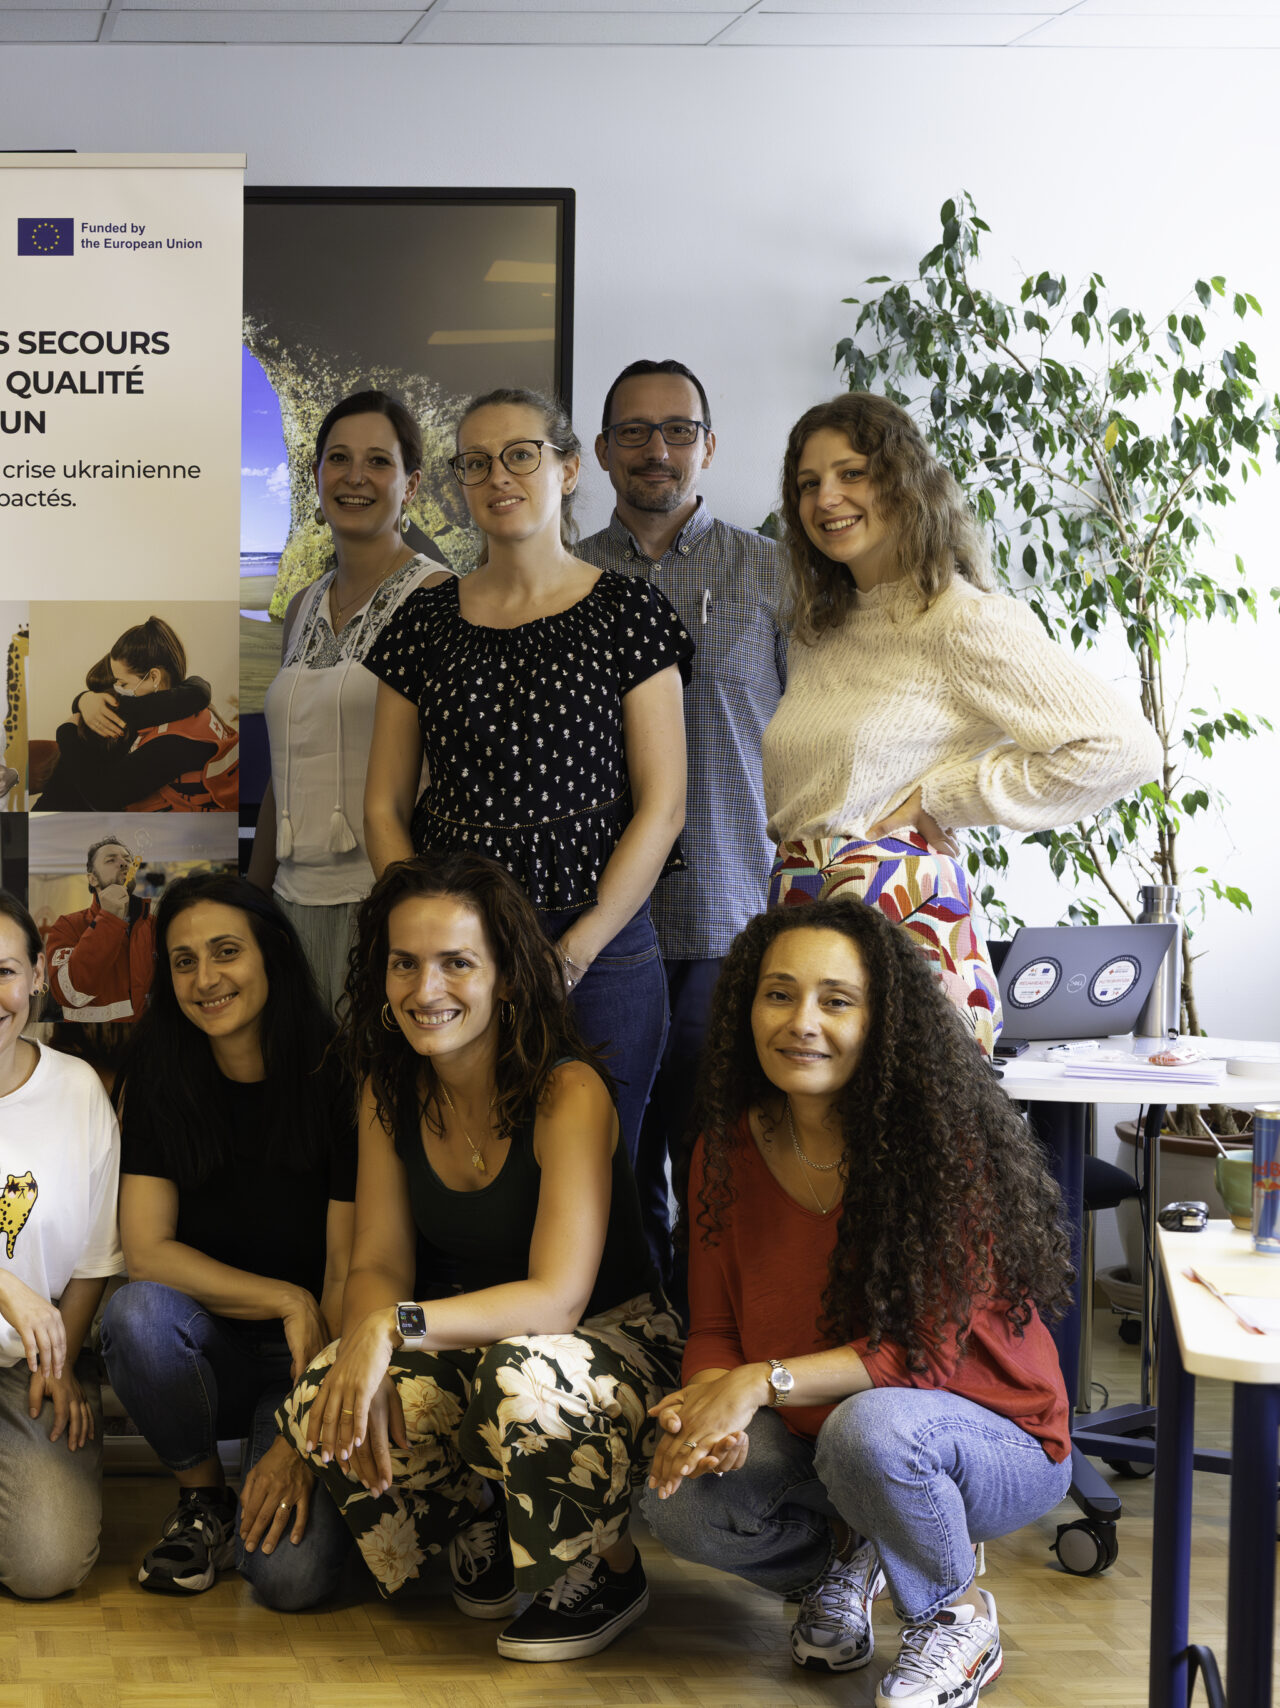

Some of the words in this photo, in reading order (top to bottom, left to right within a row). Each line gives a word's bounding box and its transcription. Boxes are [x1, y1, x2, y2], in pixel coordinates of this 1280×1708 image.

[81, 222, 128, 235] Funded
[130, 222, 146, 238] by
[81, 238, 100, 250] the
[104, 238, 163, 253] European
[166, 238, 203, 250] Union
[17, 330, 171, 356] SECOURS
[5, 364, 145, 400] QUALITÉ
[2, 459, 57, 479] crise
[62, 459, 202, 479] ukrainienne
